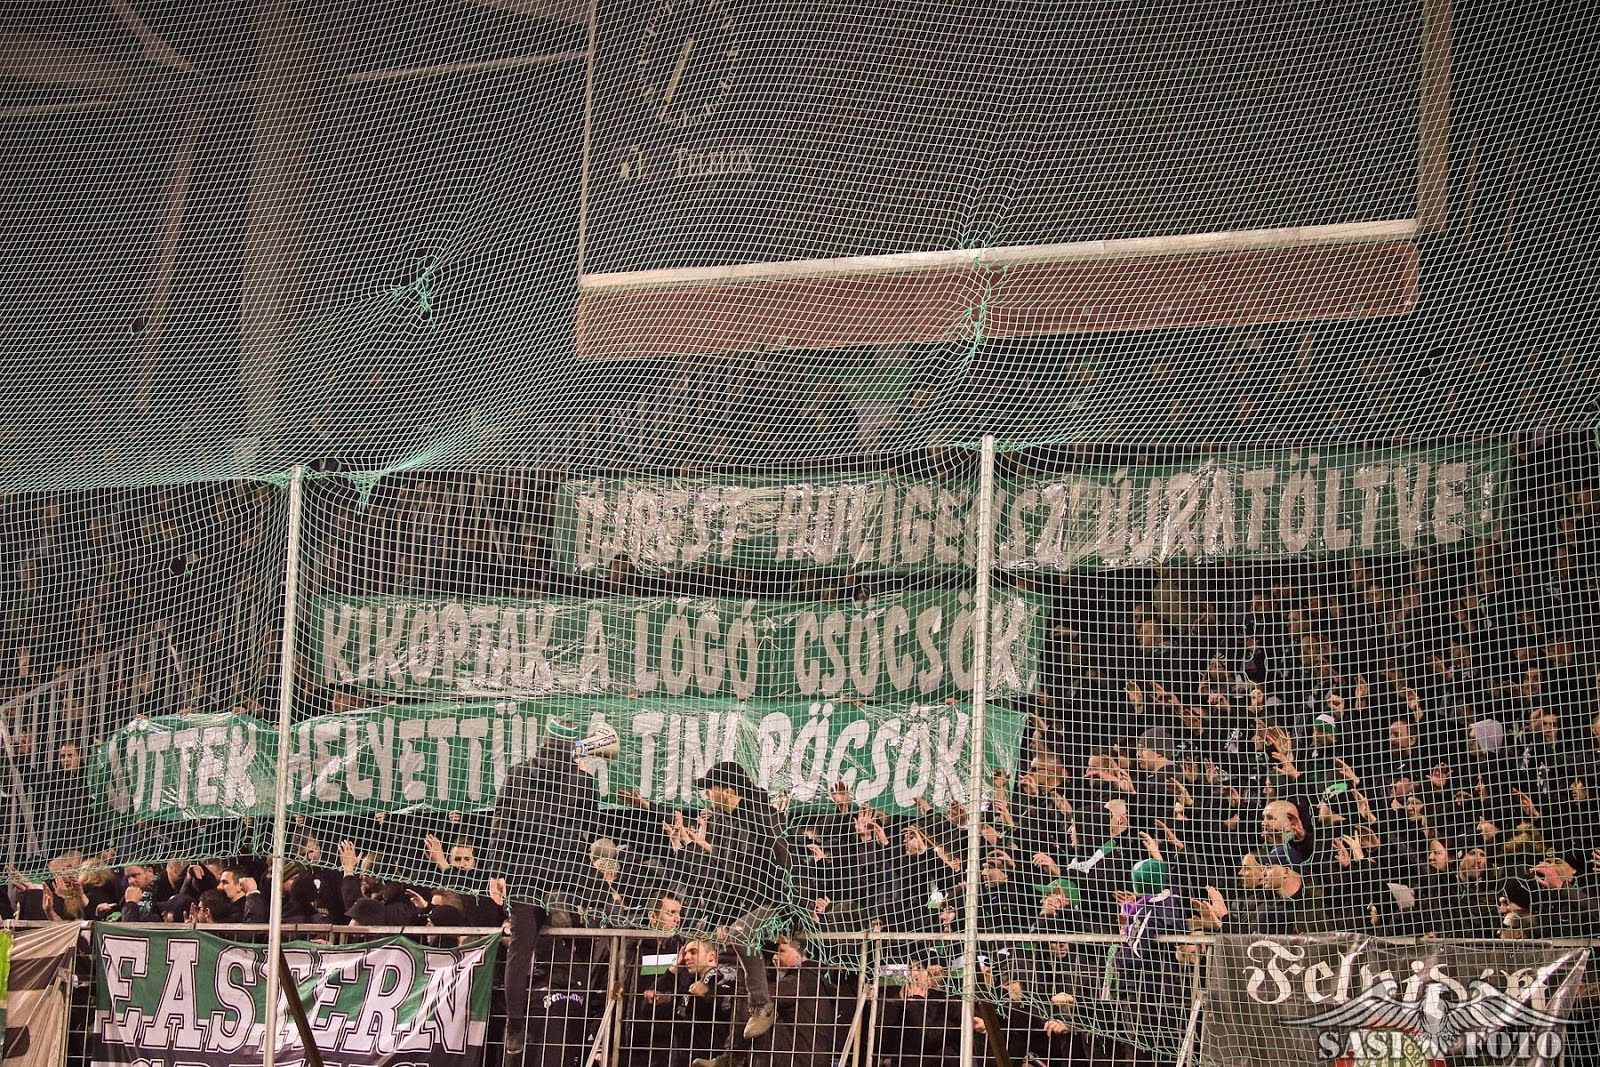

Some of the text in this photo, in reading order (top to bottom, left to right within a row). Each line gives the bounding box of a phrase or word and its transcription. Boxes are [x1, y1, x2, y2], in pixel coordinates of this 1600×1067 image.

[322, 601, 554, 692] KIKOPTAK
[578, 607, 610, 692] A
[757, 702, 969, 809] PÖCSÖK
[101, 934, 487, 1055] EASTERN
